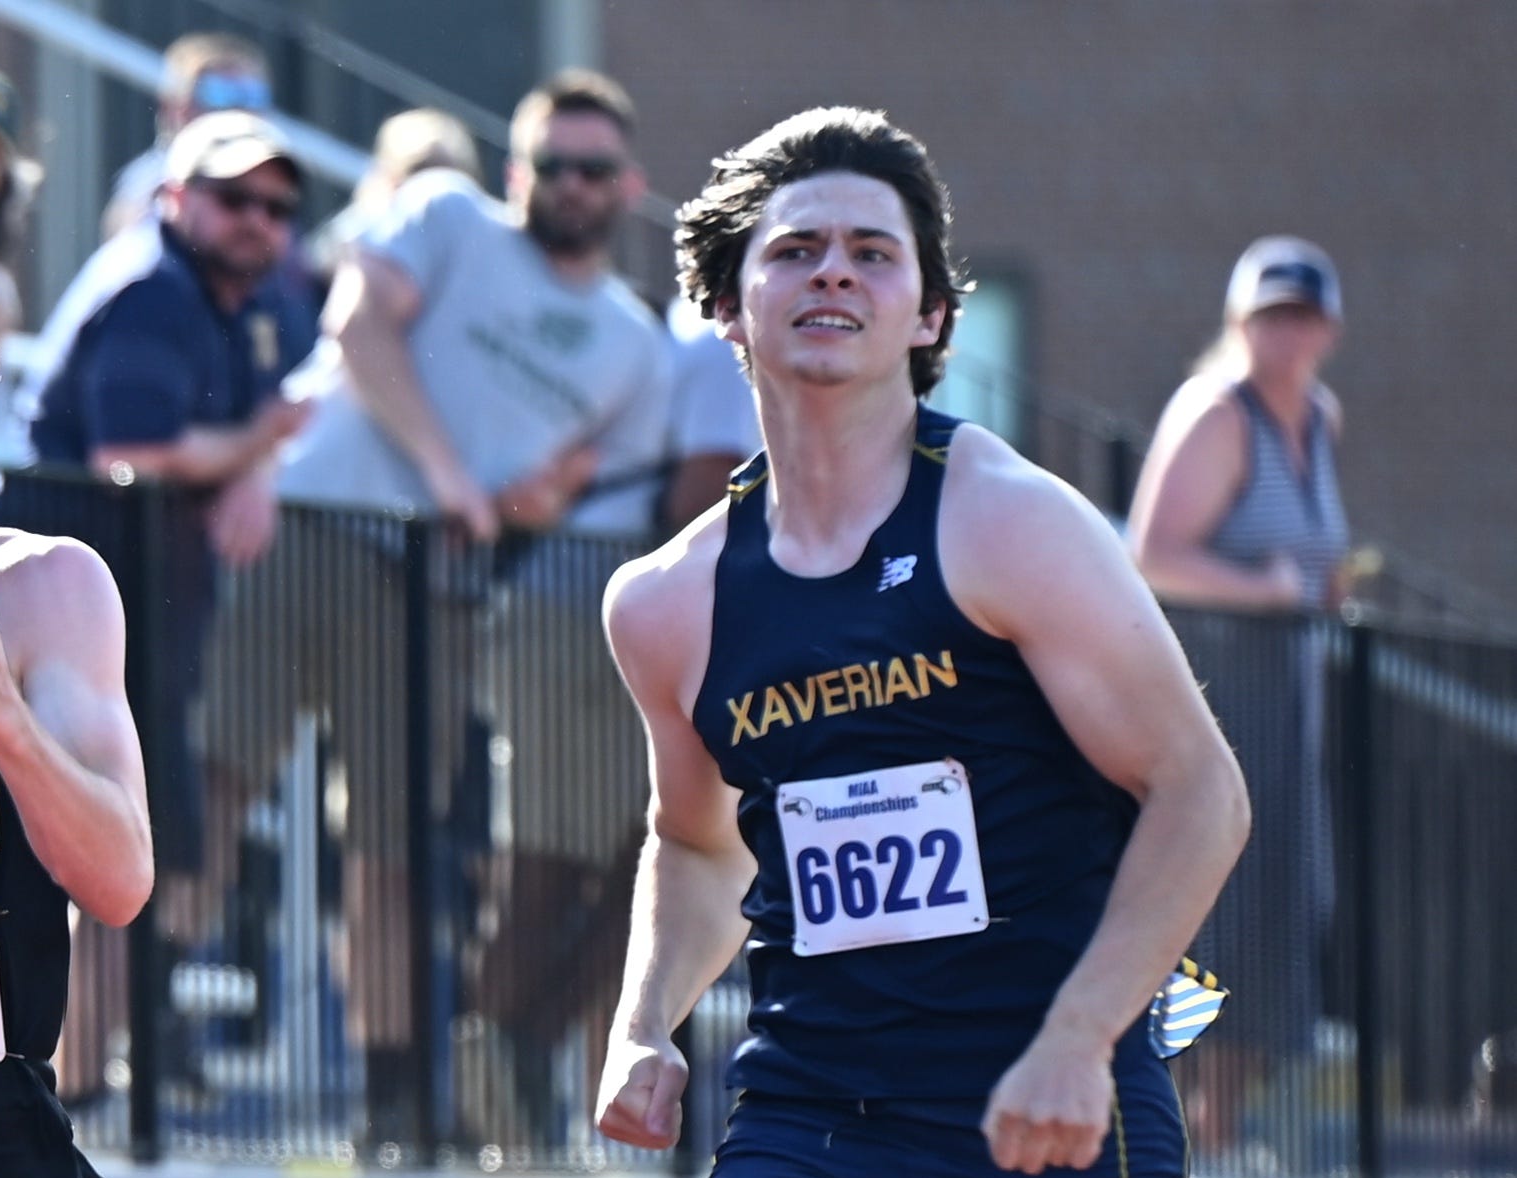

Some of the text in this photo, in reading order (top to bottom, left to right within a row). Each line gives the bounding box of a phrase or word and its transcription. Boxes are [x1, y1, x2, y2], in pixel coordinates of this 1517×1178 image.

[726, 650, 959, 747] XAVERIAN
[815, 796, 919, 822] Championships
[847, 779, 879, 798] MIAA
[796, 828, 969, 925] 6622
